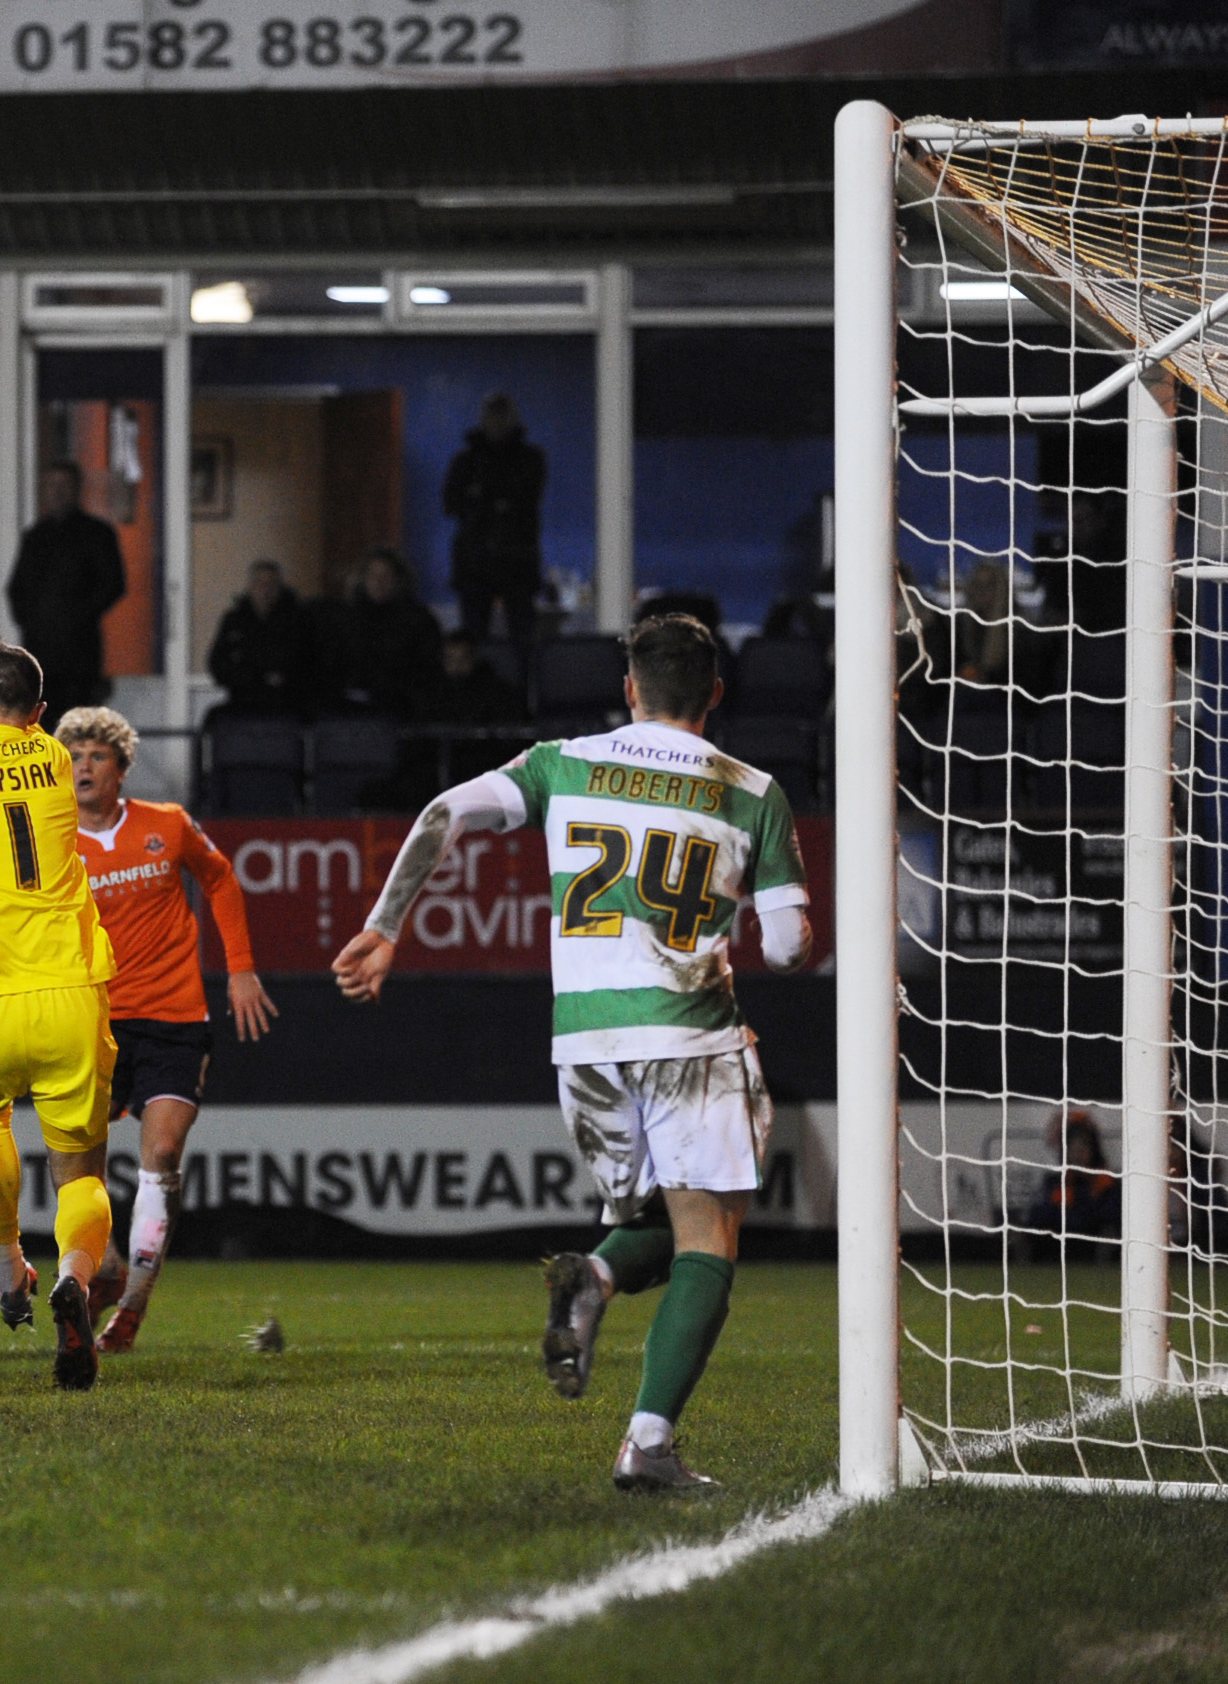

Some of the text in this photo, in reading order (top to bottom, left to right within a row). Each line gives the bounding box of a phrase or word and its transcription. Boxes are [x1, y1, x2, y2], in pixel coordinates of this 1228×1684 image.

[13, 14, 522, 73] 01582 883222
[1100, 23, 1228, 55] ALWAY
[610, 740, 715, 768] THATCHERS
[587, 765, 724, 814] ROBERTS
[3, 801, 42, 891] 1
[88, 860, 170, 891] BARNFIELD
[559, 821, 718, 952] 24
